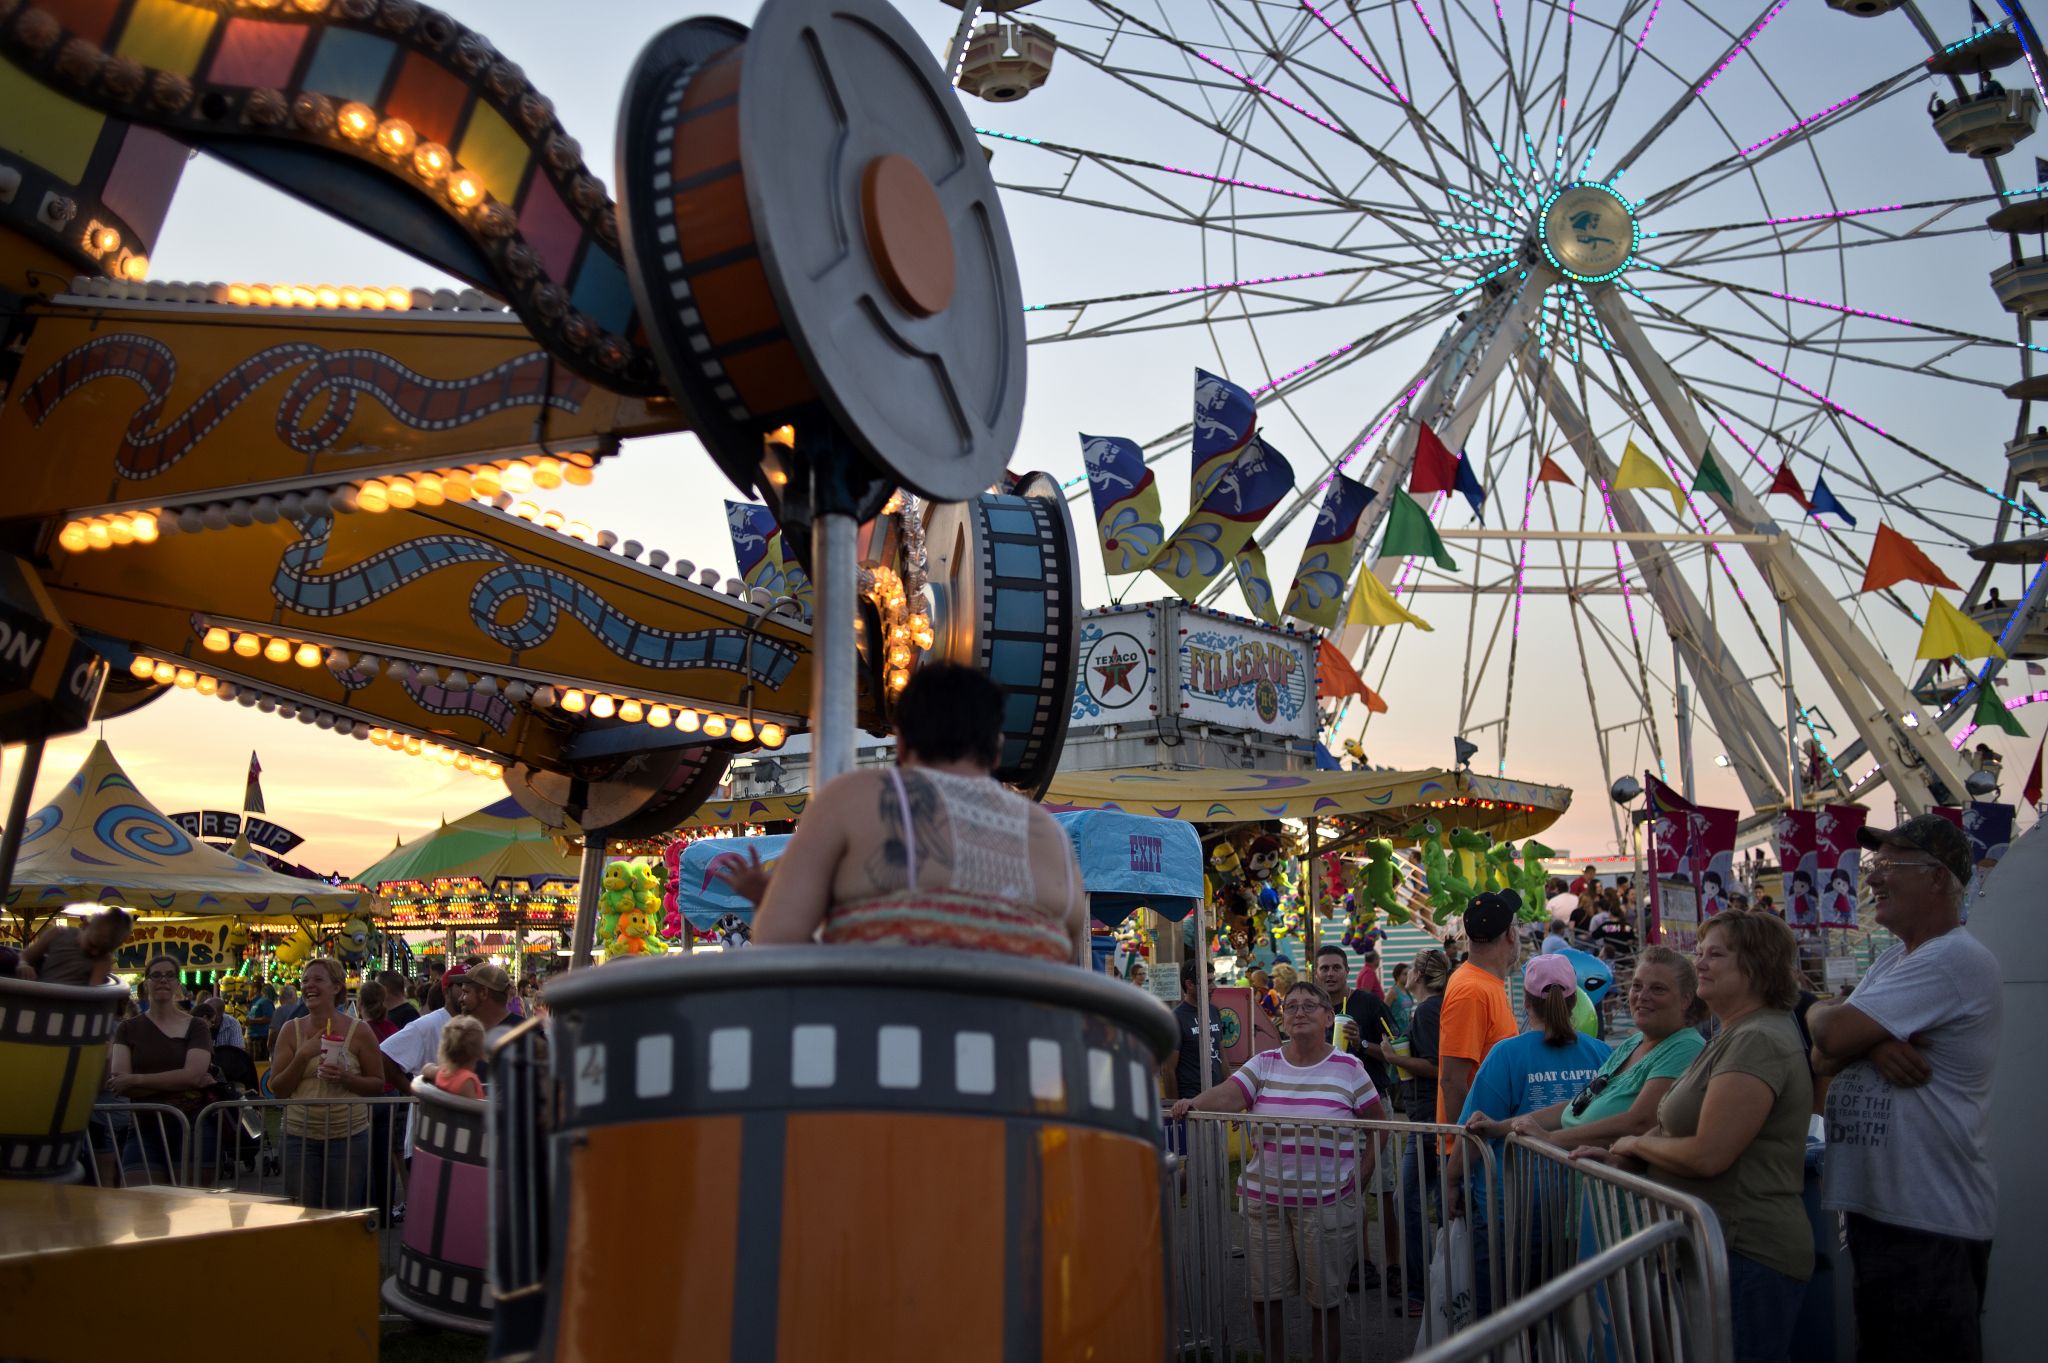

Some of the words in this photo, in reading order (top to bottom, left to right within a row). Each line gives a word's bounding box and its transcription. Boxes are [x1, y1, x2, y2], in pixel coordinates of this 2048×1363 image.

[1095, 652, 1138, 666] TEXACO
[172, 813, 291, 847] ARSHIP
[1129, 834, 1162, 873] EXIT
[1527, 1071, 1557, 1084] BOAT
[1841, 1095, 1860, 1107] OF
